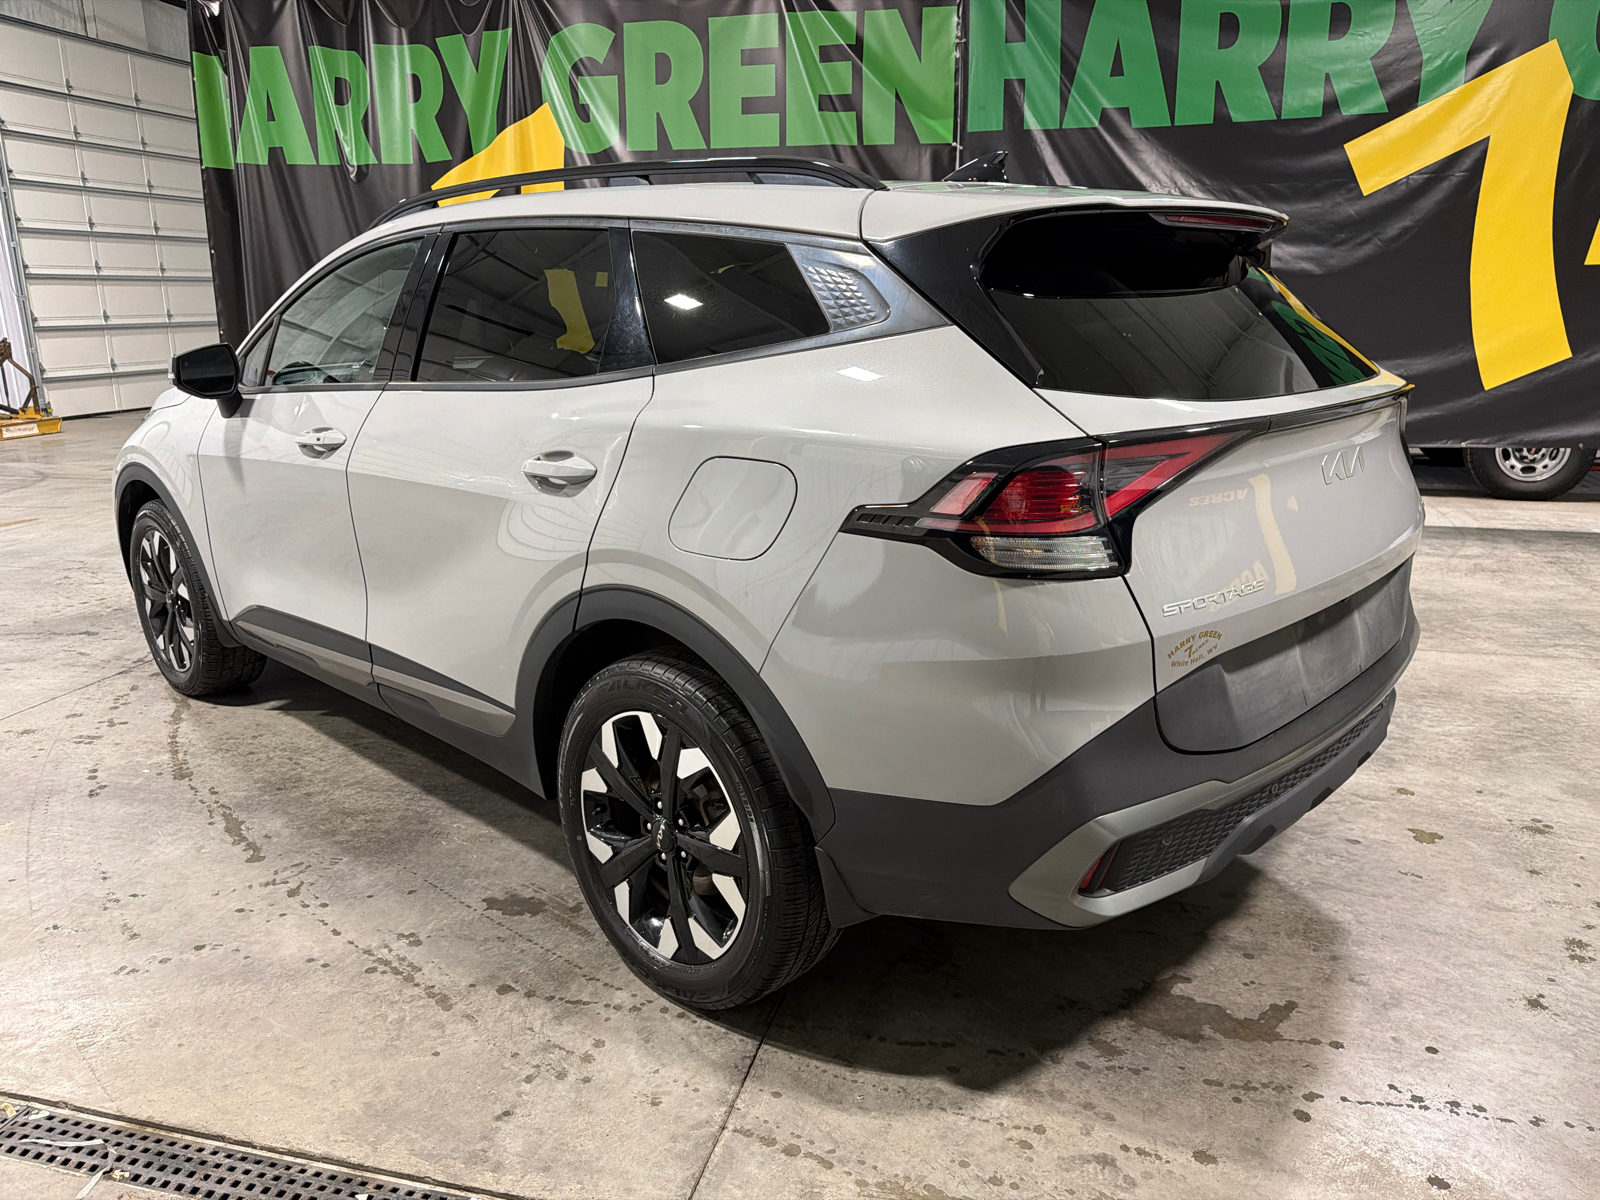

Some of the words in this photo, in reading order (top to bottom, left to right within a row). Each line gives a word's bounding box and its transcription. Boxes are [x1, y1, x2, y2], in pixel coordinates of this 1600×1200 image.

[541, 5, 958, 154] GREEN
[967, 0, 1492, 132] HARRY
[1343, 39, 1574, 390] 7
[1321, 445, 1365, 486] KIA
[1162, 580, 1265, 617] SPORTAGE
[1167, 633, 1196, 659] HARRY
[1198, 630, 1222, 640] GREEN
[1184, 644, 1193, 658] 7
[1207, 643, 1217, 655] WV
